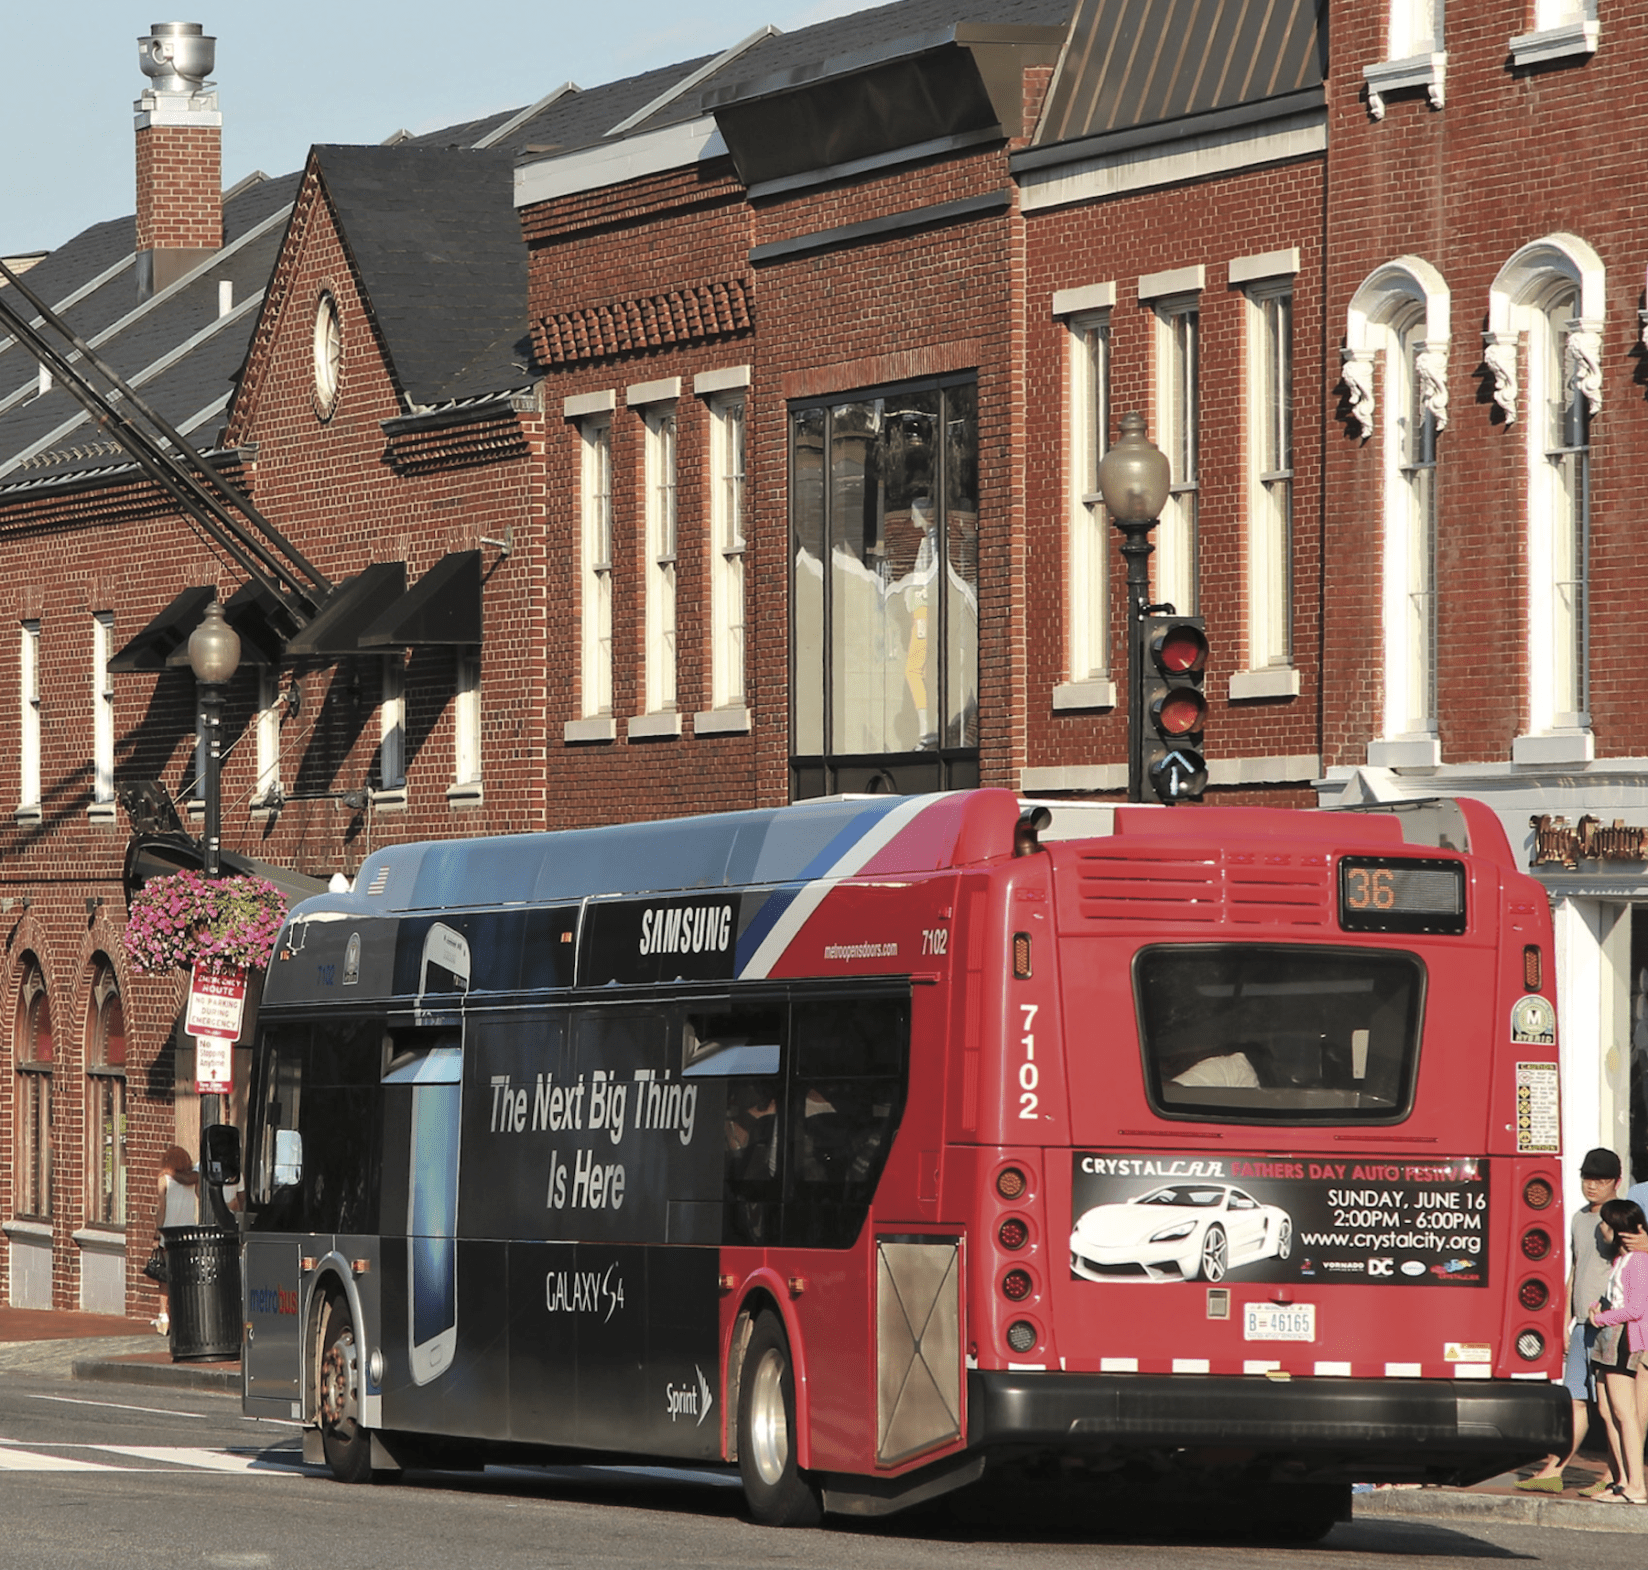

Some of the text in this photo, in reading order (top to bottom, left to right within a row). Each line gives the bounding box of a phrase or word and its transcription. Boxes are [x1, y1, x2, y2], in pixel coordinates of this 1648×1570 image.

[1347, 868, 1395, 909] 36
[639, 905, 732, 956] SAMSUNG
[823, 940, 899, 963] metroopensdoors.com
[922, 928, 948, 956] 7102
[202, 984, 235, 997] ROUTE
[195, 996, 238, 1009] NO PARKING
[201, 1007, 230, 1018] DURING
[191, 1015, 237, 1029] EMERGENCY
[1526, 1009, 1542, 1025] M
[199, 1040, 212, 1048] No
[1018, 1004, 1039, 1119] 7102
[490, 1069, 698, 1145] The Next Big Thing
[546, 1149, 626, 1210] Is Here
[1230, 1161, 1305, 1179] FATHERS
[1308, 1164, 1344, 1180] DAY
[1352, 1165, 1400, 1181] AUTO
[1405, 1165, 1483, 1182] FESTIVAL
[1327, 1189, 1487, 1210] SUNDAY, JUNE 16
[1333, 1210, 1400, 1228] 2:00PM
[1415, 1212, 1482, 1230] 6:00PM
[1301, 1231, 1482, 1254] www.crystalcity.org
[1322, 1261, 1365, 1269] VORNADO
[1368, 1258, 1394, 1276] DC
[250, 1284, 299, 1316] metrobus
[546, 1271, 601, 1313] GALAXY
[666, 1382, 698, 1422] Sprint
